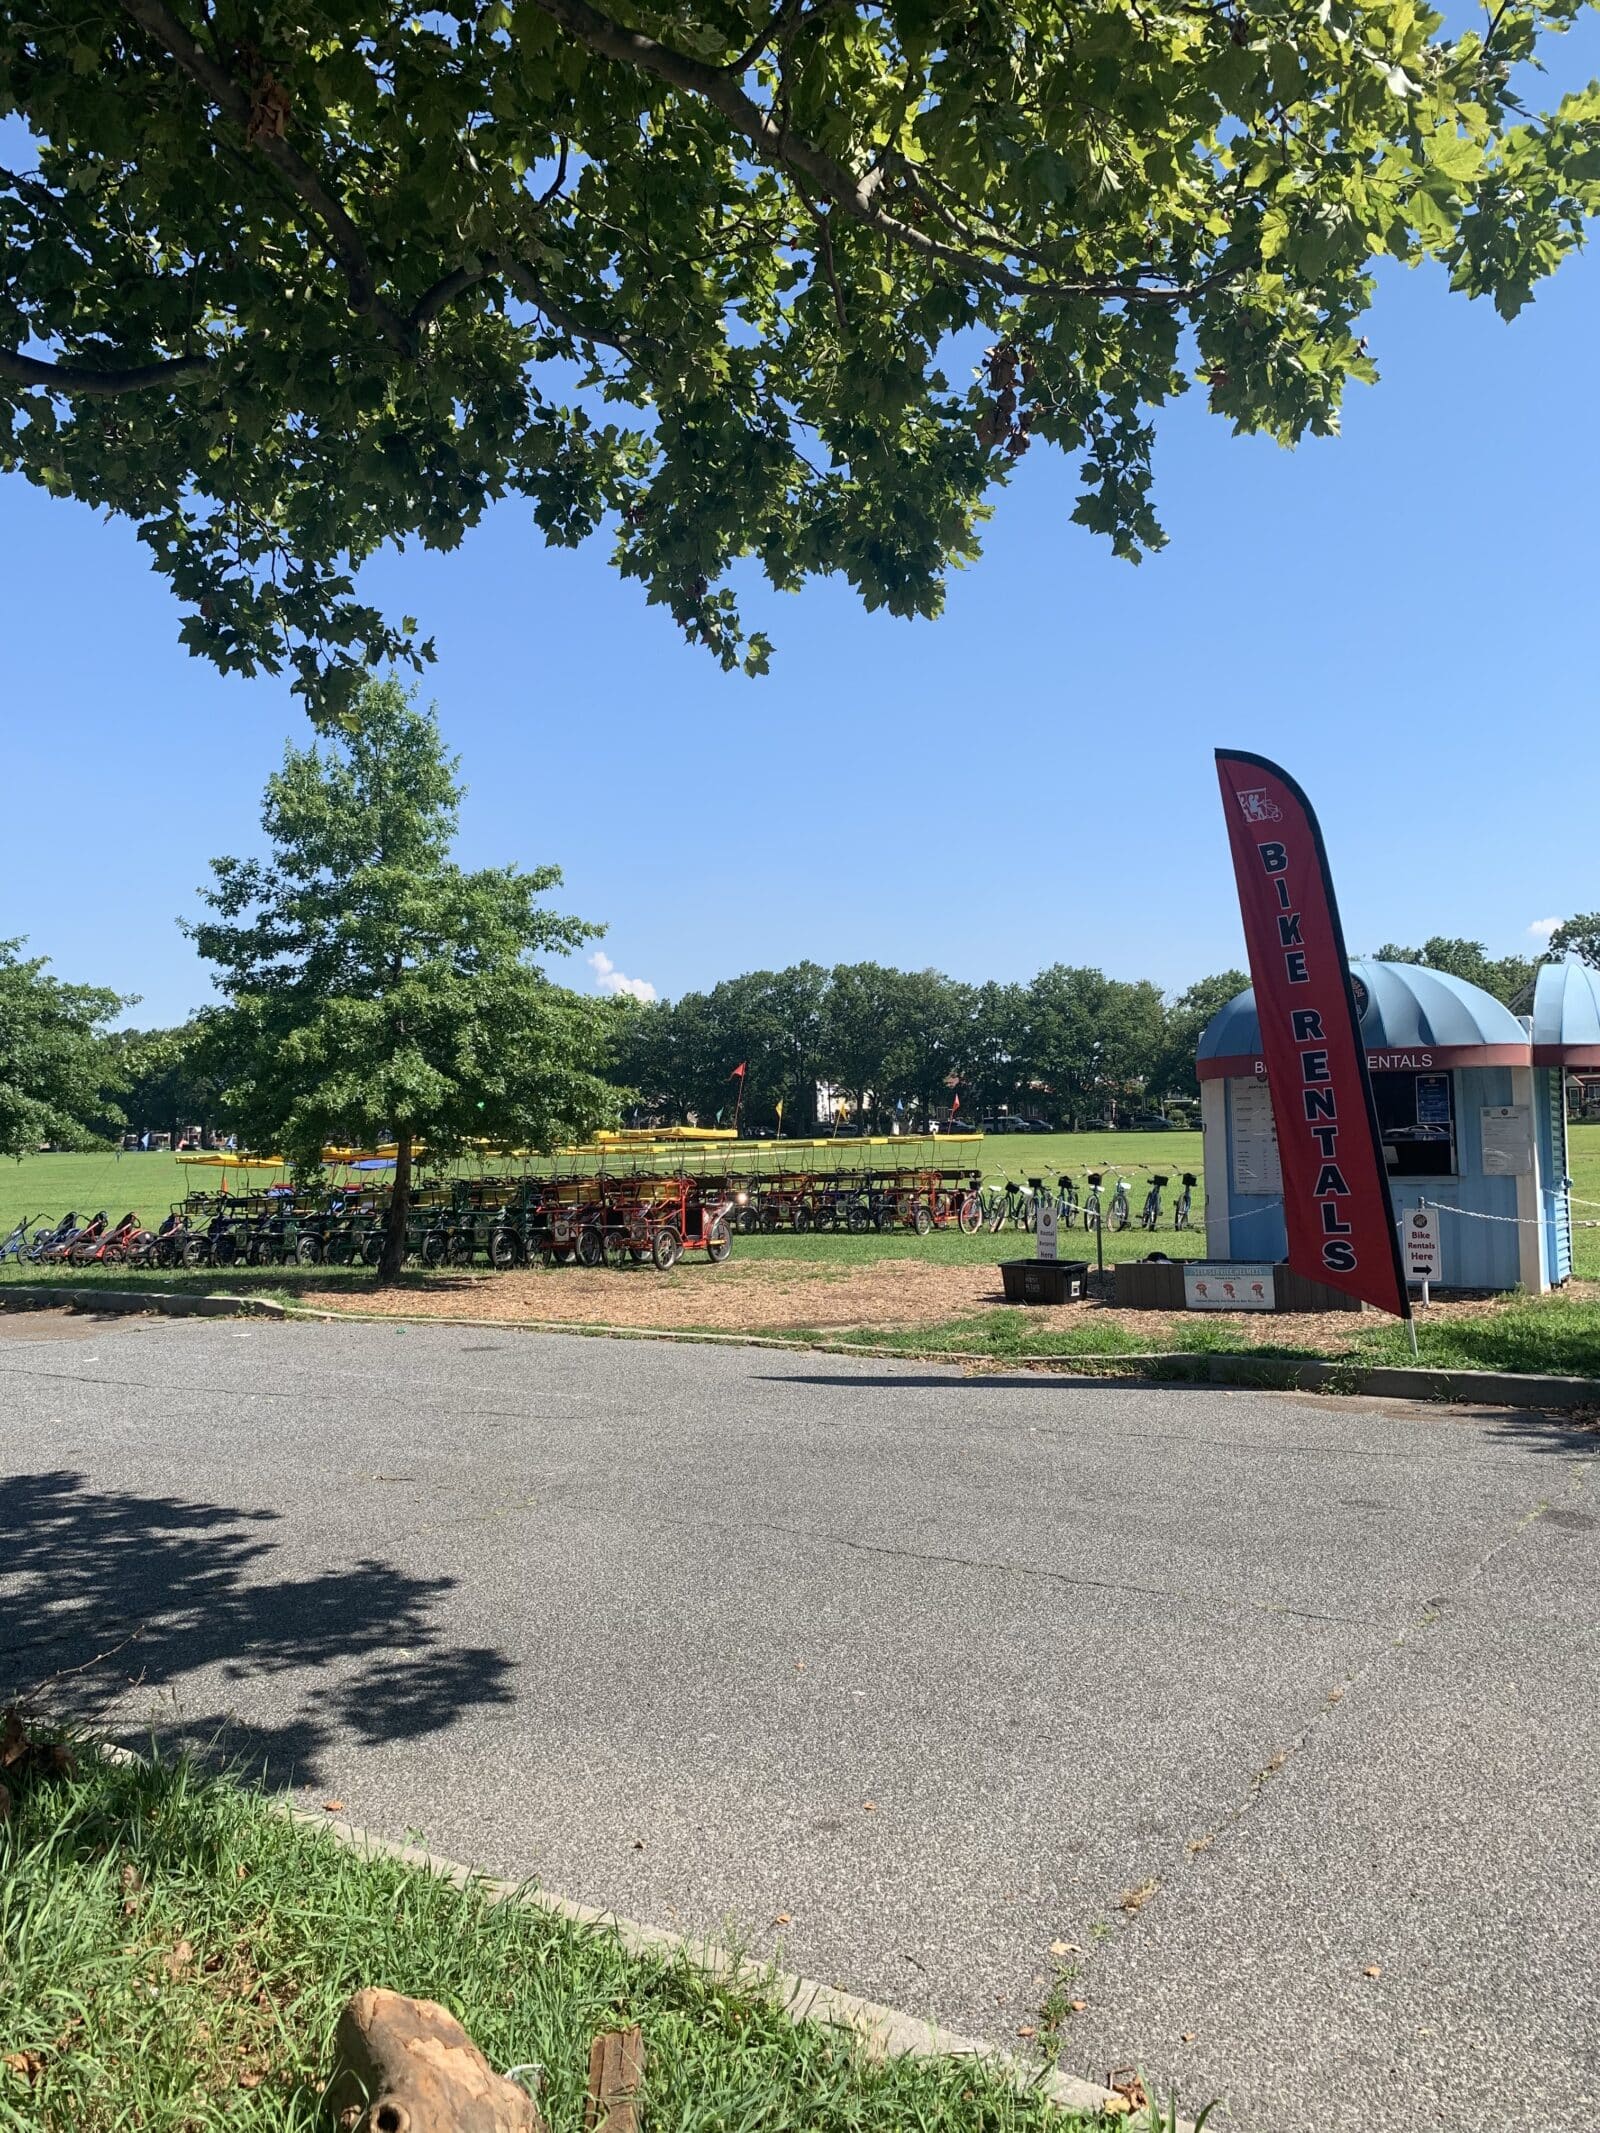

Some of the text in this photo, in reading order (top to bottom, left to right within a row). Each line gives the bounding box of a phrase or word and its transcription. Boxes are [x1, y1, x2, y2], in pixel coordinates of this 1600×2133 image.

[1257, 841, 1357, 1272] BIKE RENTALS
[1366, 1053, 1433, 1069] ENTALS
[1411, 1231, 1431, 1240] Bike
[1407, 1242, 1436, 1250] Rentals
[1411, 1252, 1434, 1261] Here
